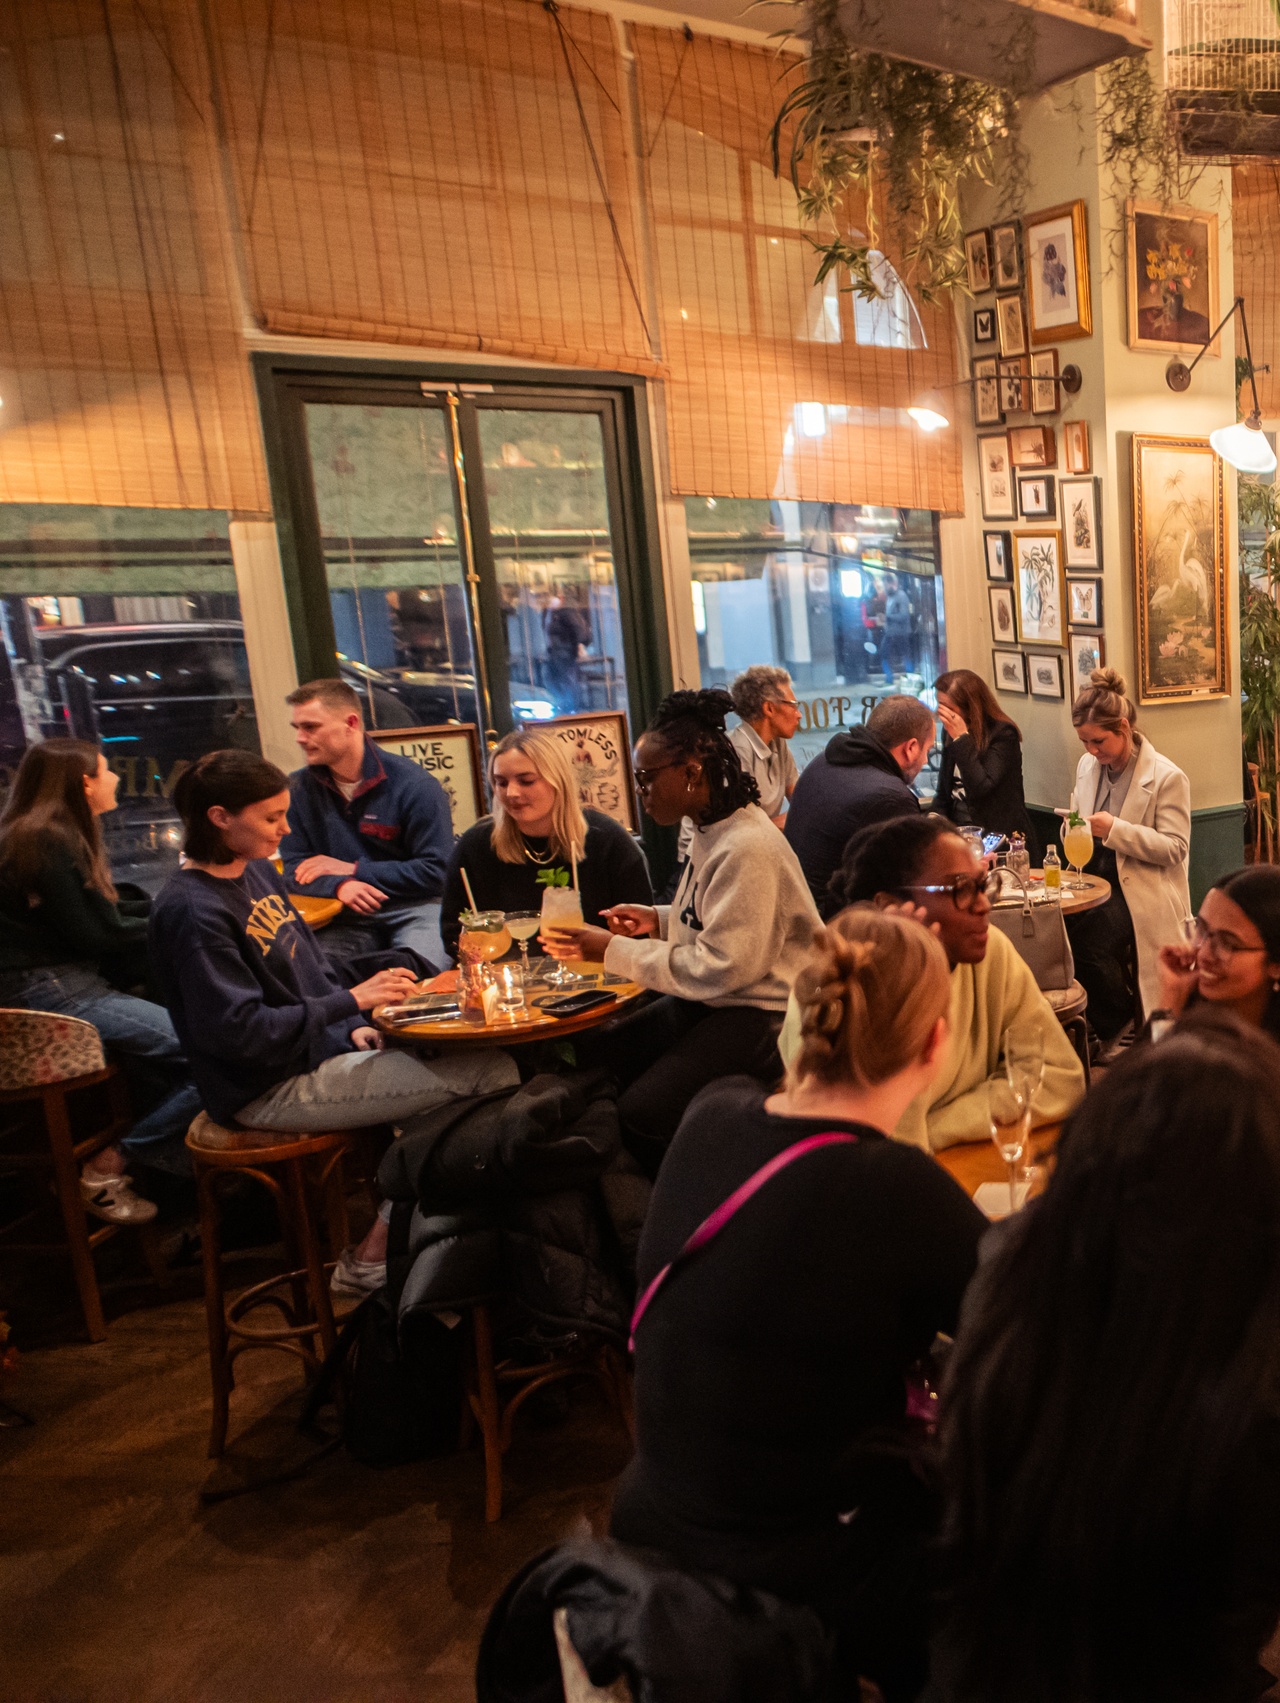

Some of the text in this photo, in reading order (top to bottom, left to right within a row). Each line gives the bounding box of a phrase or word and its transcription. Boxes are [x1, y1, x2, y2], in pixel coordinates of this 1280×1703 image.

[401, 742, 444, 758] LIVE
[557, 728, 618, 760] TOMLESS
[420, 756, 454, 771] SIC
[245, 894, 297, 957] NIKE
